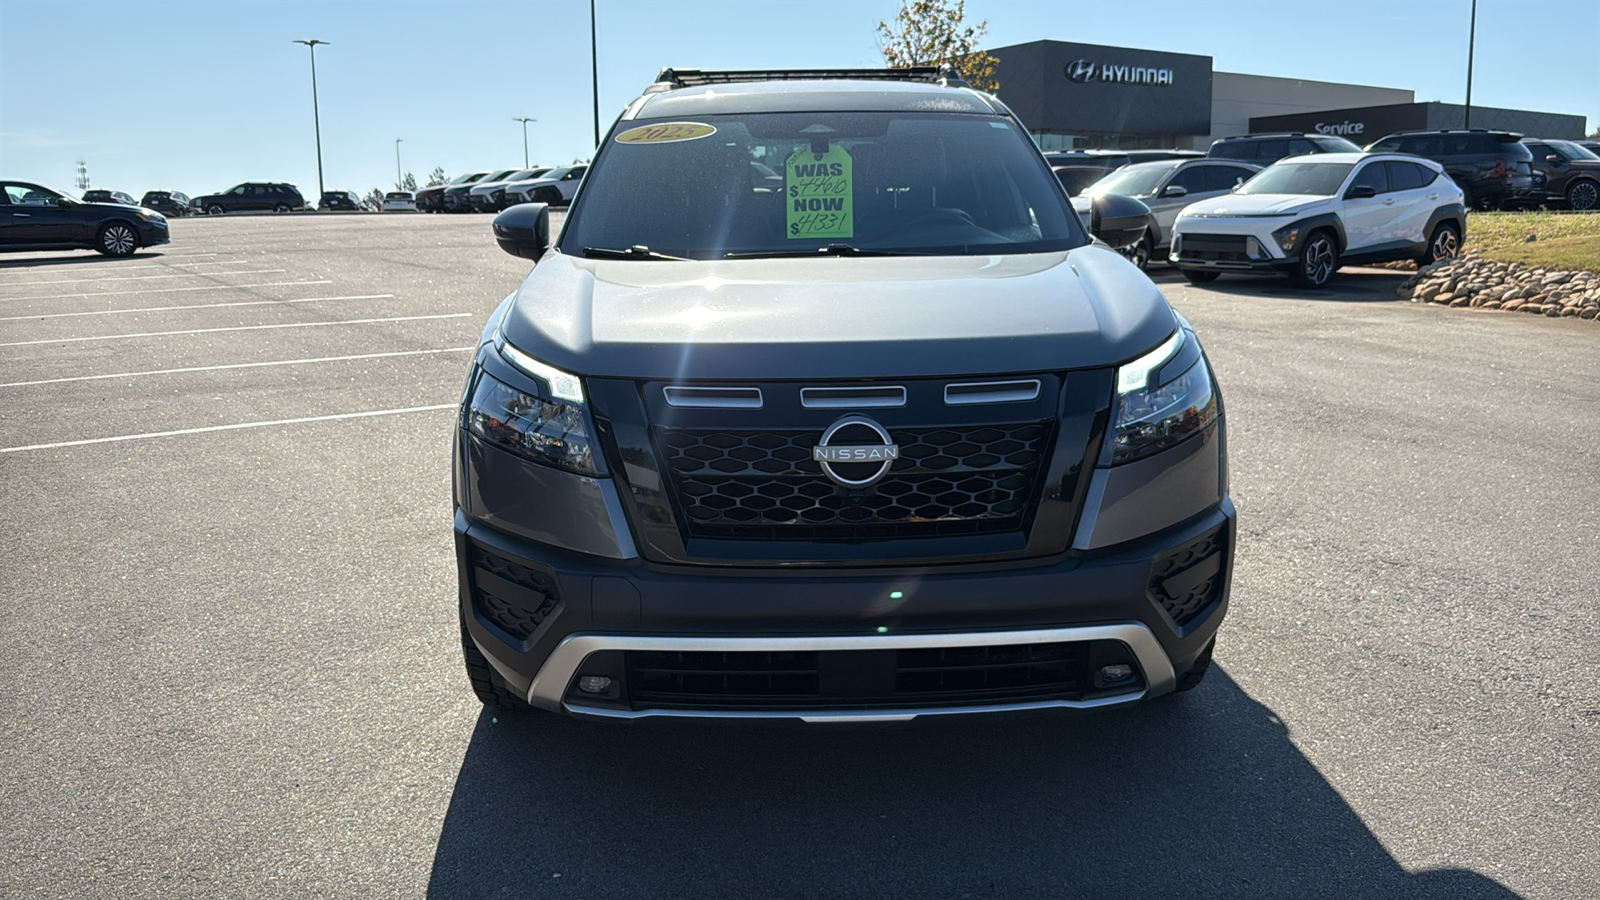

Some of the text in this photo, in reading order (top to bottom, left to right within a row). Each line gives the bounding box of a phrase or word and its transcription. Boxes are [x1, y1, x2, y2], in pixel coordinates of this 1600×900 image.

[1102, 64, 1172, 84] HYUNDAI
[628, 125, 700, 142] 2025
[1314, 120, 1364, 135] Service
[795, 163, 843, 178] WAS
[794, 198, 844, 212] NOW
[815, 447, 897, 460] NISSAN
